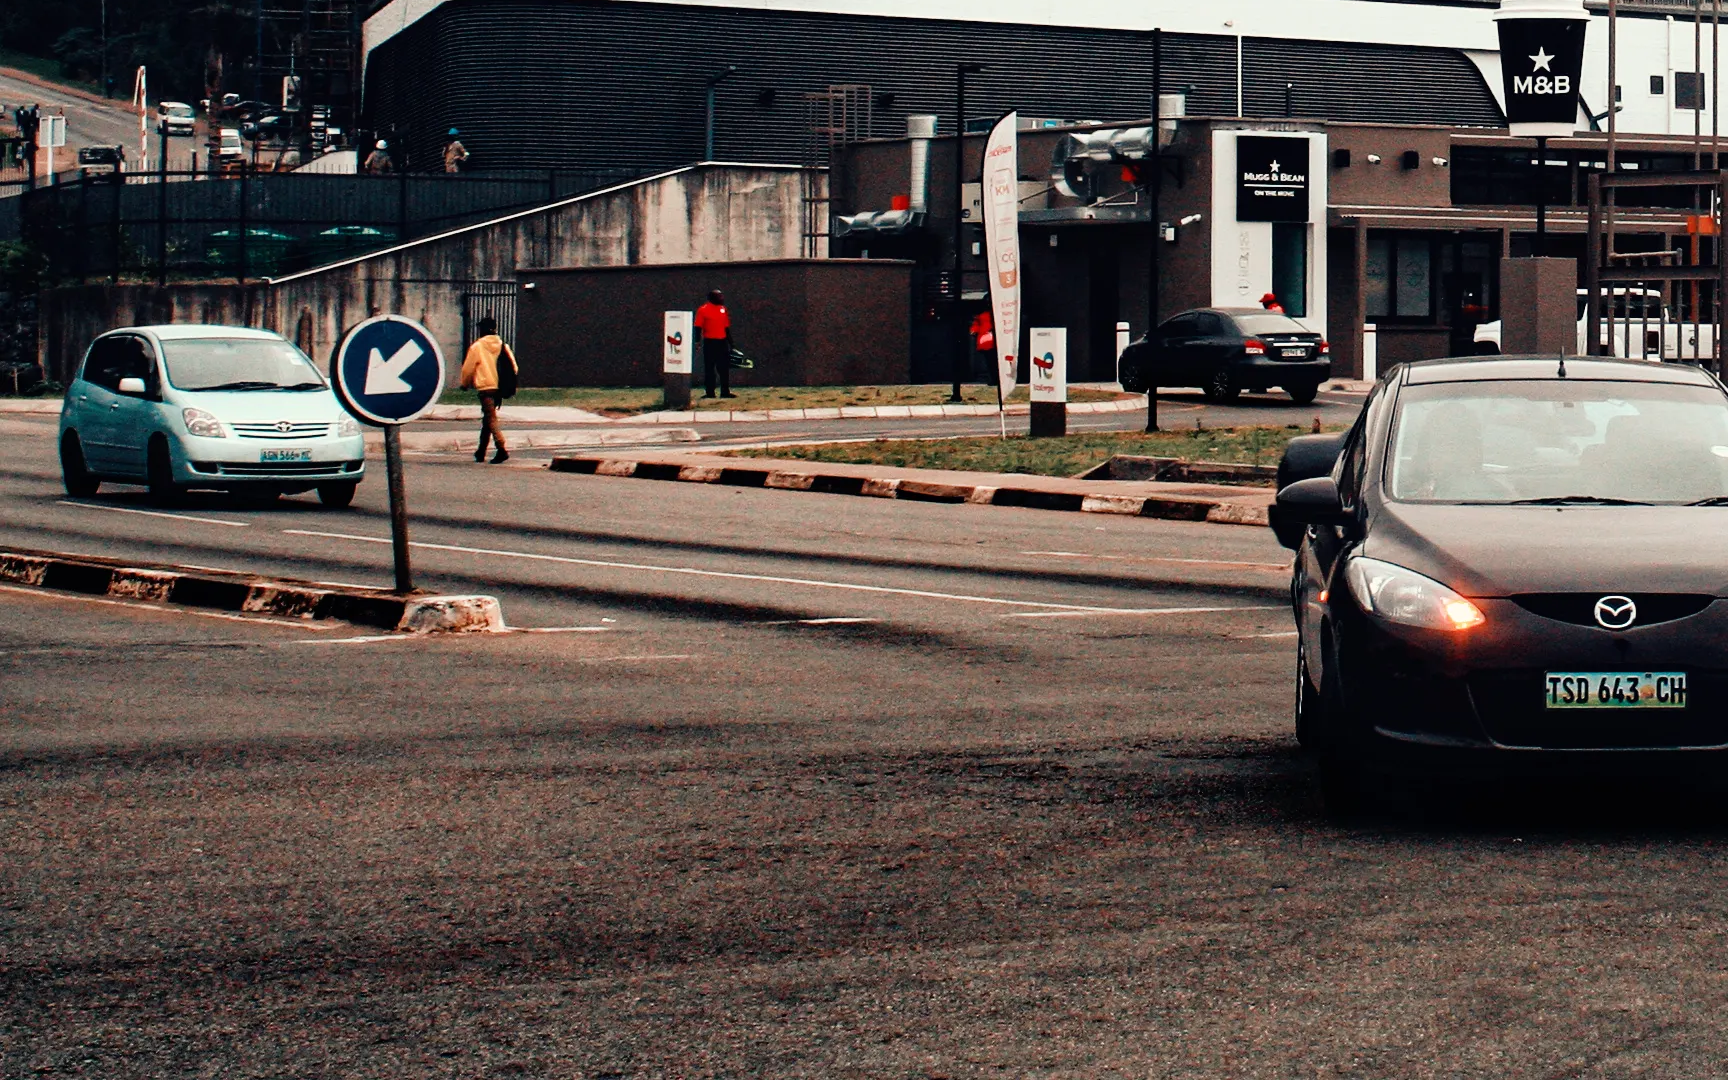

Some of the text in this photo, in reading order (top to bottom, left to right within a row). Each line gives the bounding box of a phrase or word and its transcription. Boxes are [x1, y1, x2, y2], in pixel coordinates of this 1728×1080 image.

[1513, 75, 1570, 94] M&B
[1271, 173, 1279, 181] &
[1548, 676, 1684, 704] TSD 643 CH
